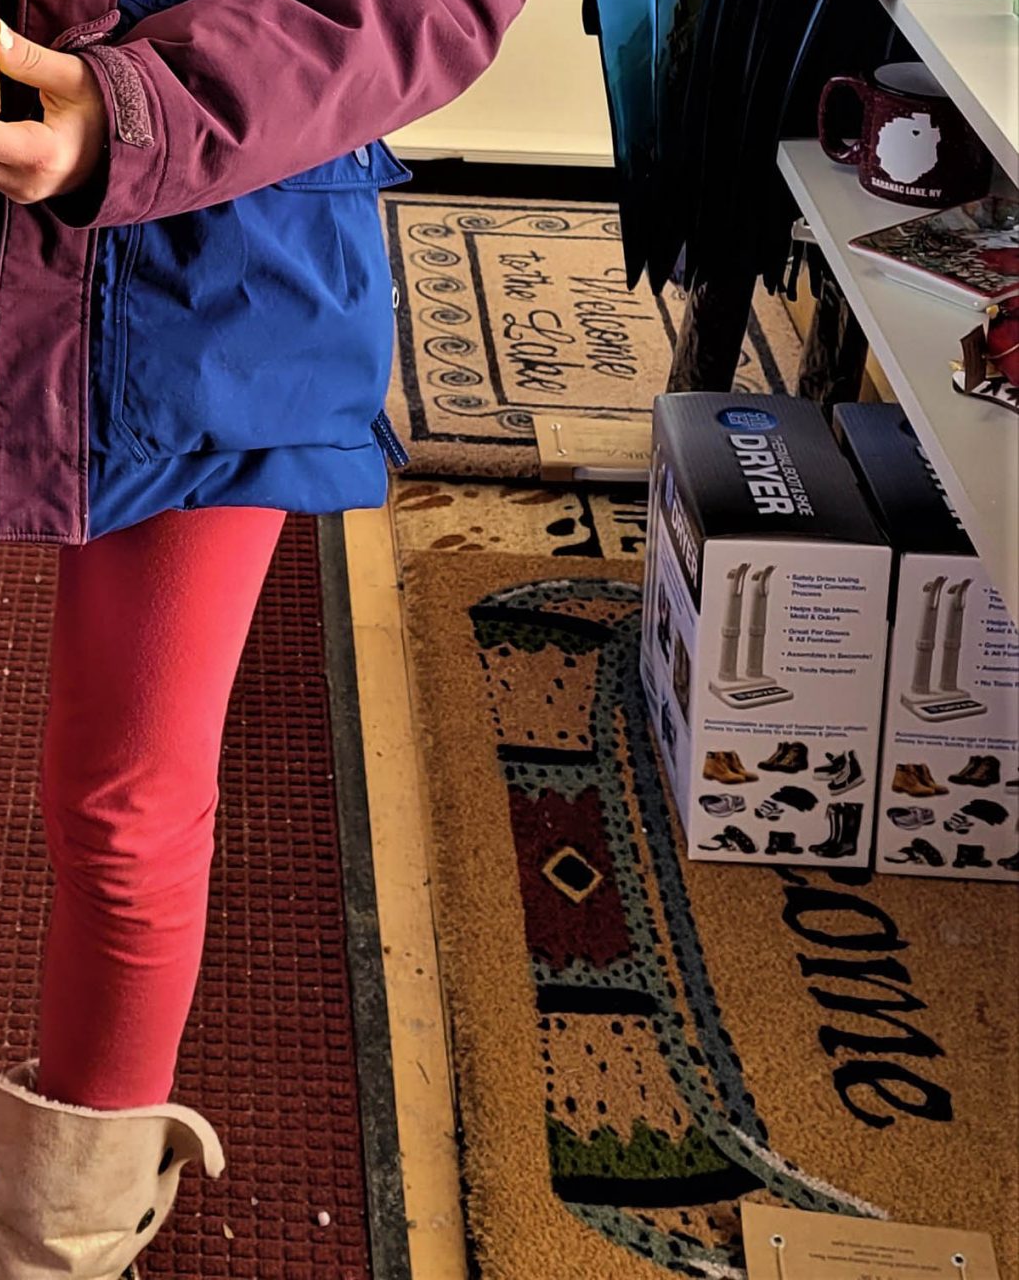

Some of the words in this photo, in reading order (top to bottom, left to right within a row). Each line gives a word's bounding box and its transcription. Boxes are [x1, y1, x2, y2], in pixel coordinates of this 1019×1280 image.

[871, 177, 905, 194] SARANAC
[929, 189, 942, 197] NY
[502, 309, 585, 395] Lake
[567, 268, 654, 380] Welcome
[729, 434, 795, 514] DRYER
